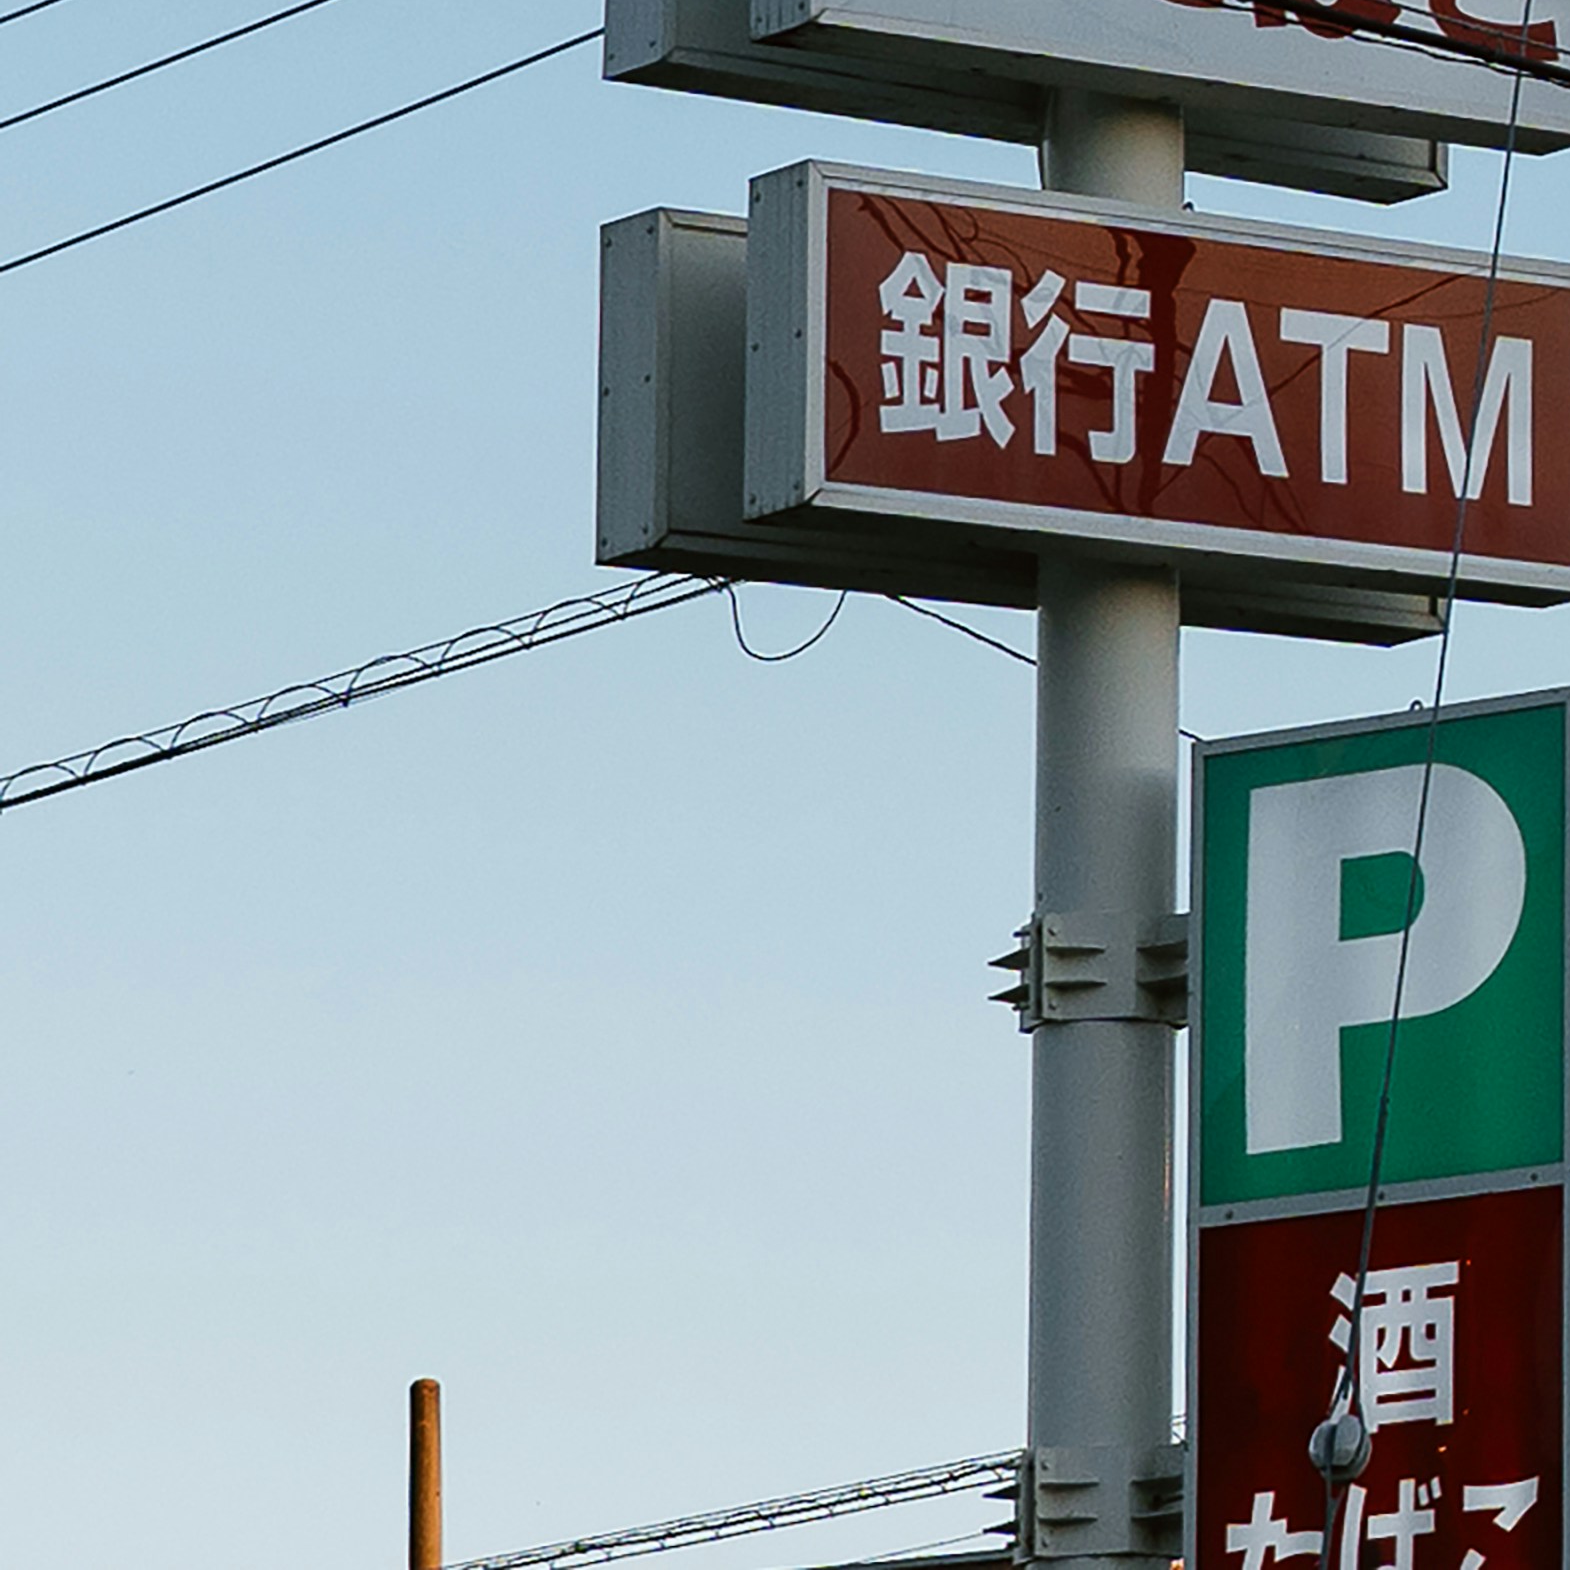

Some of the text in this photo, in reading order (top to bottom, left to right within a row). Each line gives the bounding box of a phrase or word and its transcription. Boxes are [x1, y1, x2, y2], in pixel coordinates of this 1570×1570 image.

[878, 251, 1533, 508] 銀行ATM
[1245, 762, 1526, 1155] P
[1328, 1260, 1459, 1434] 酒
